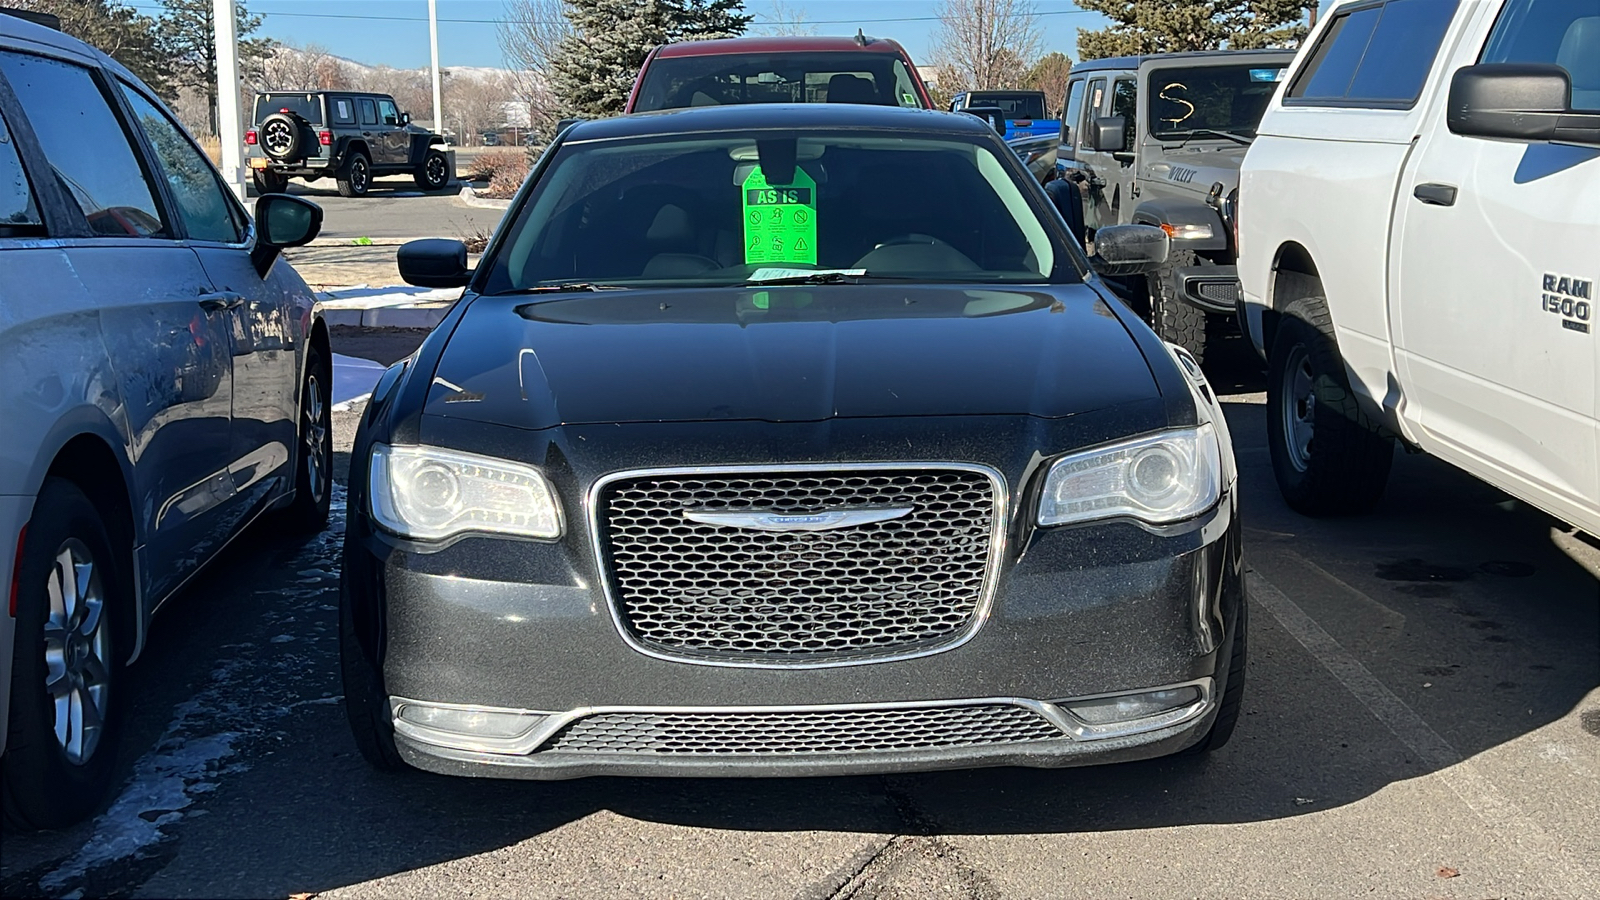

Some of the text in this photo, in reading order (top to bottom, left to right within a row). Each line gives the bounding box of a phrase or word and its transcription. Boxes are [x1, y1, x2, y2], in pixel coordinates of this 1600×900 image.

[1159, 82, 1195, 122] S
[1168, 166, 1197, 183] WILLYS
[757, 190, 799, 204] AS IS
[1543, 273, 1592, 300] RAM
[1542, 293, 1590, 321] 1500
